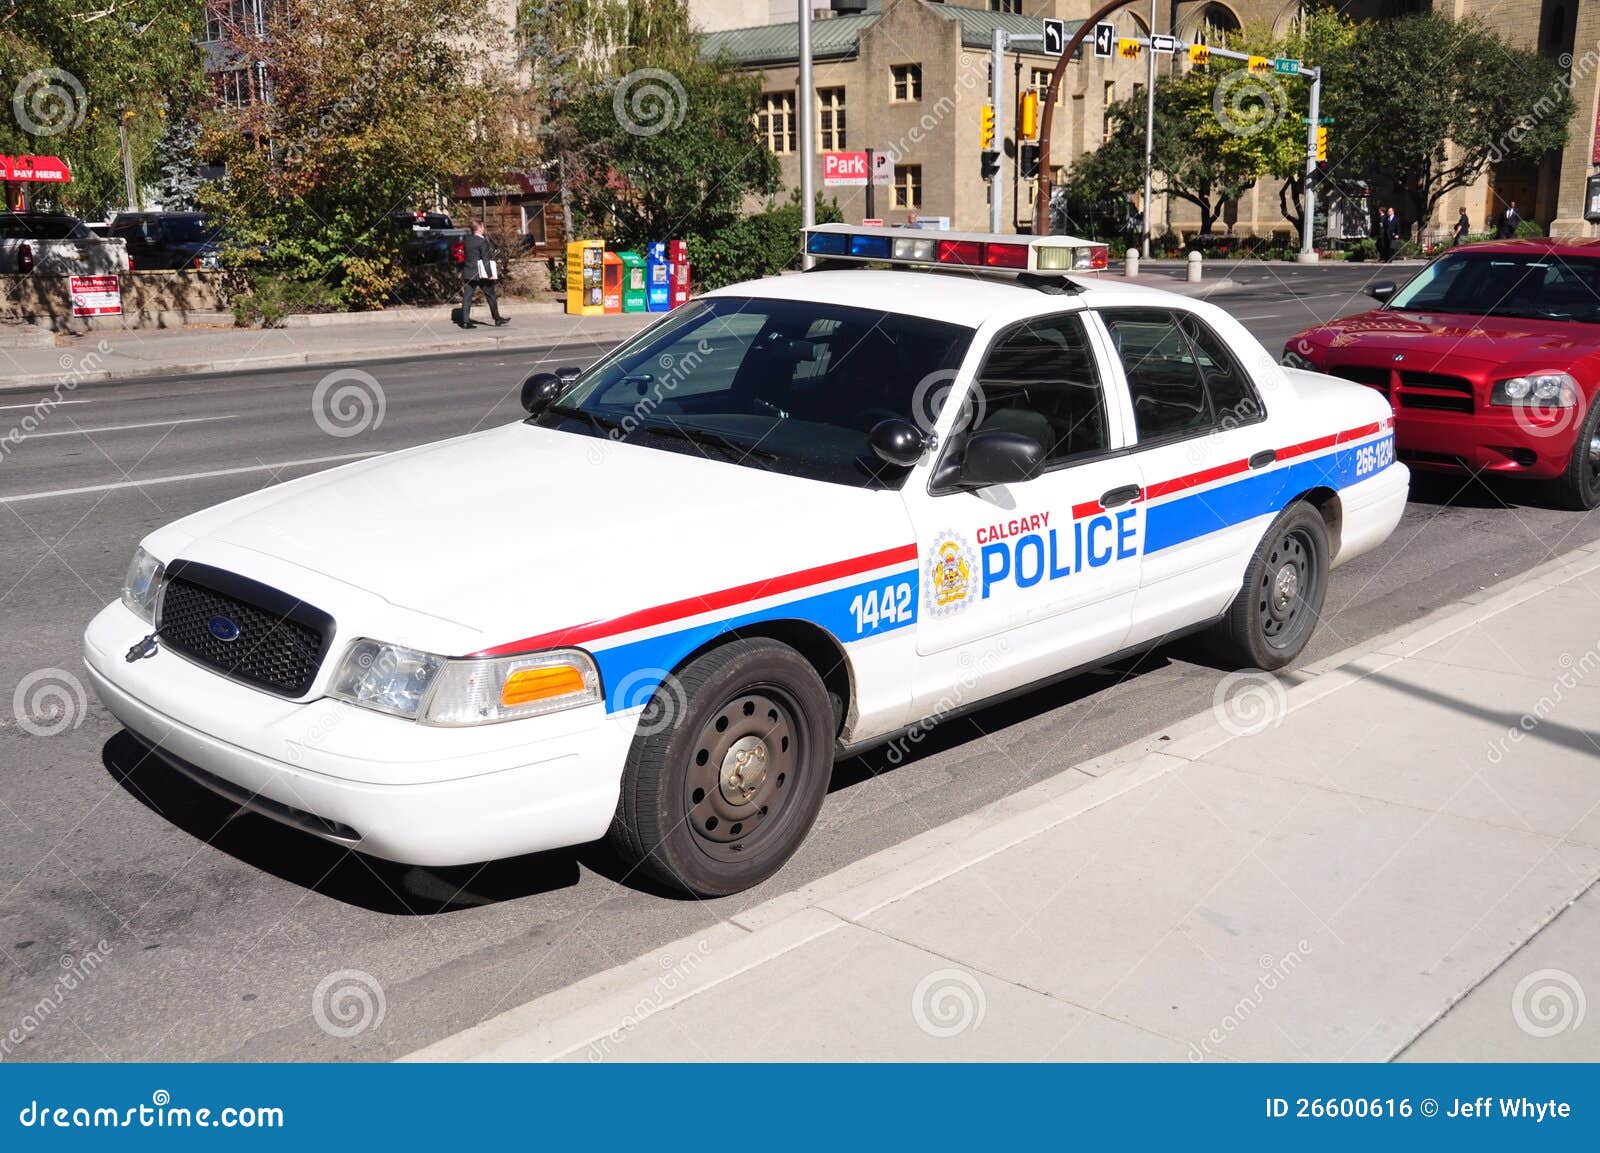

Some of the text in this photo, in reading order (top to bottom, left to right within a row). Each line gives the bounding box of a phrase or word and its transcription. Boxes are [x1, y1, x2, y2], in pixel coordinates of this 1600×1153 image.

[13, 169, 33, 178] PAY
[35, 170, 63, 179] HERE
[826, 155, 865, 174] Park
[1356, 437, 1393, 477] 266-1234
[976, 511, 1050, 545] CALGARY
[981, 507, 1138, 600] POLICE
[849, 582, 913, 635] 1442
